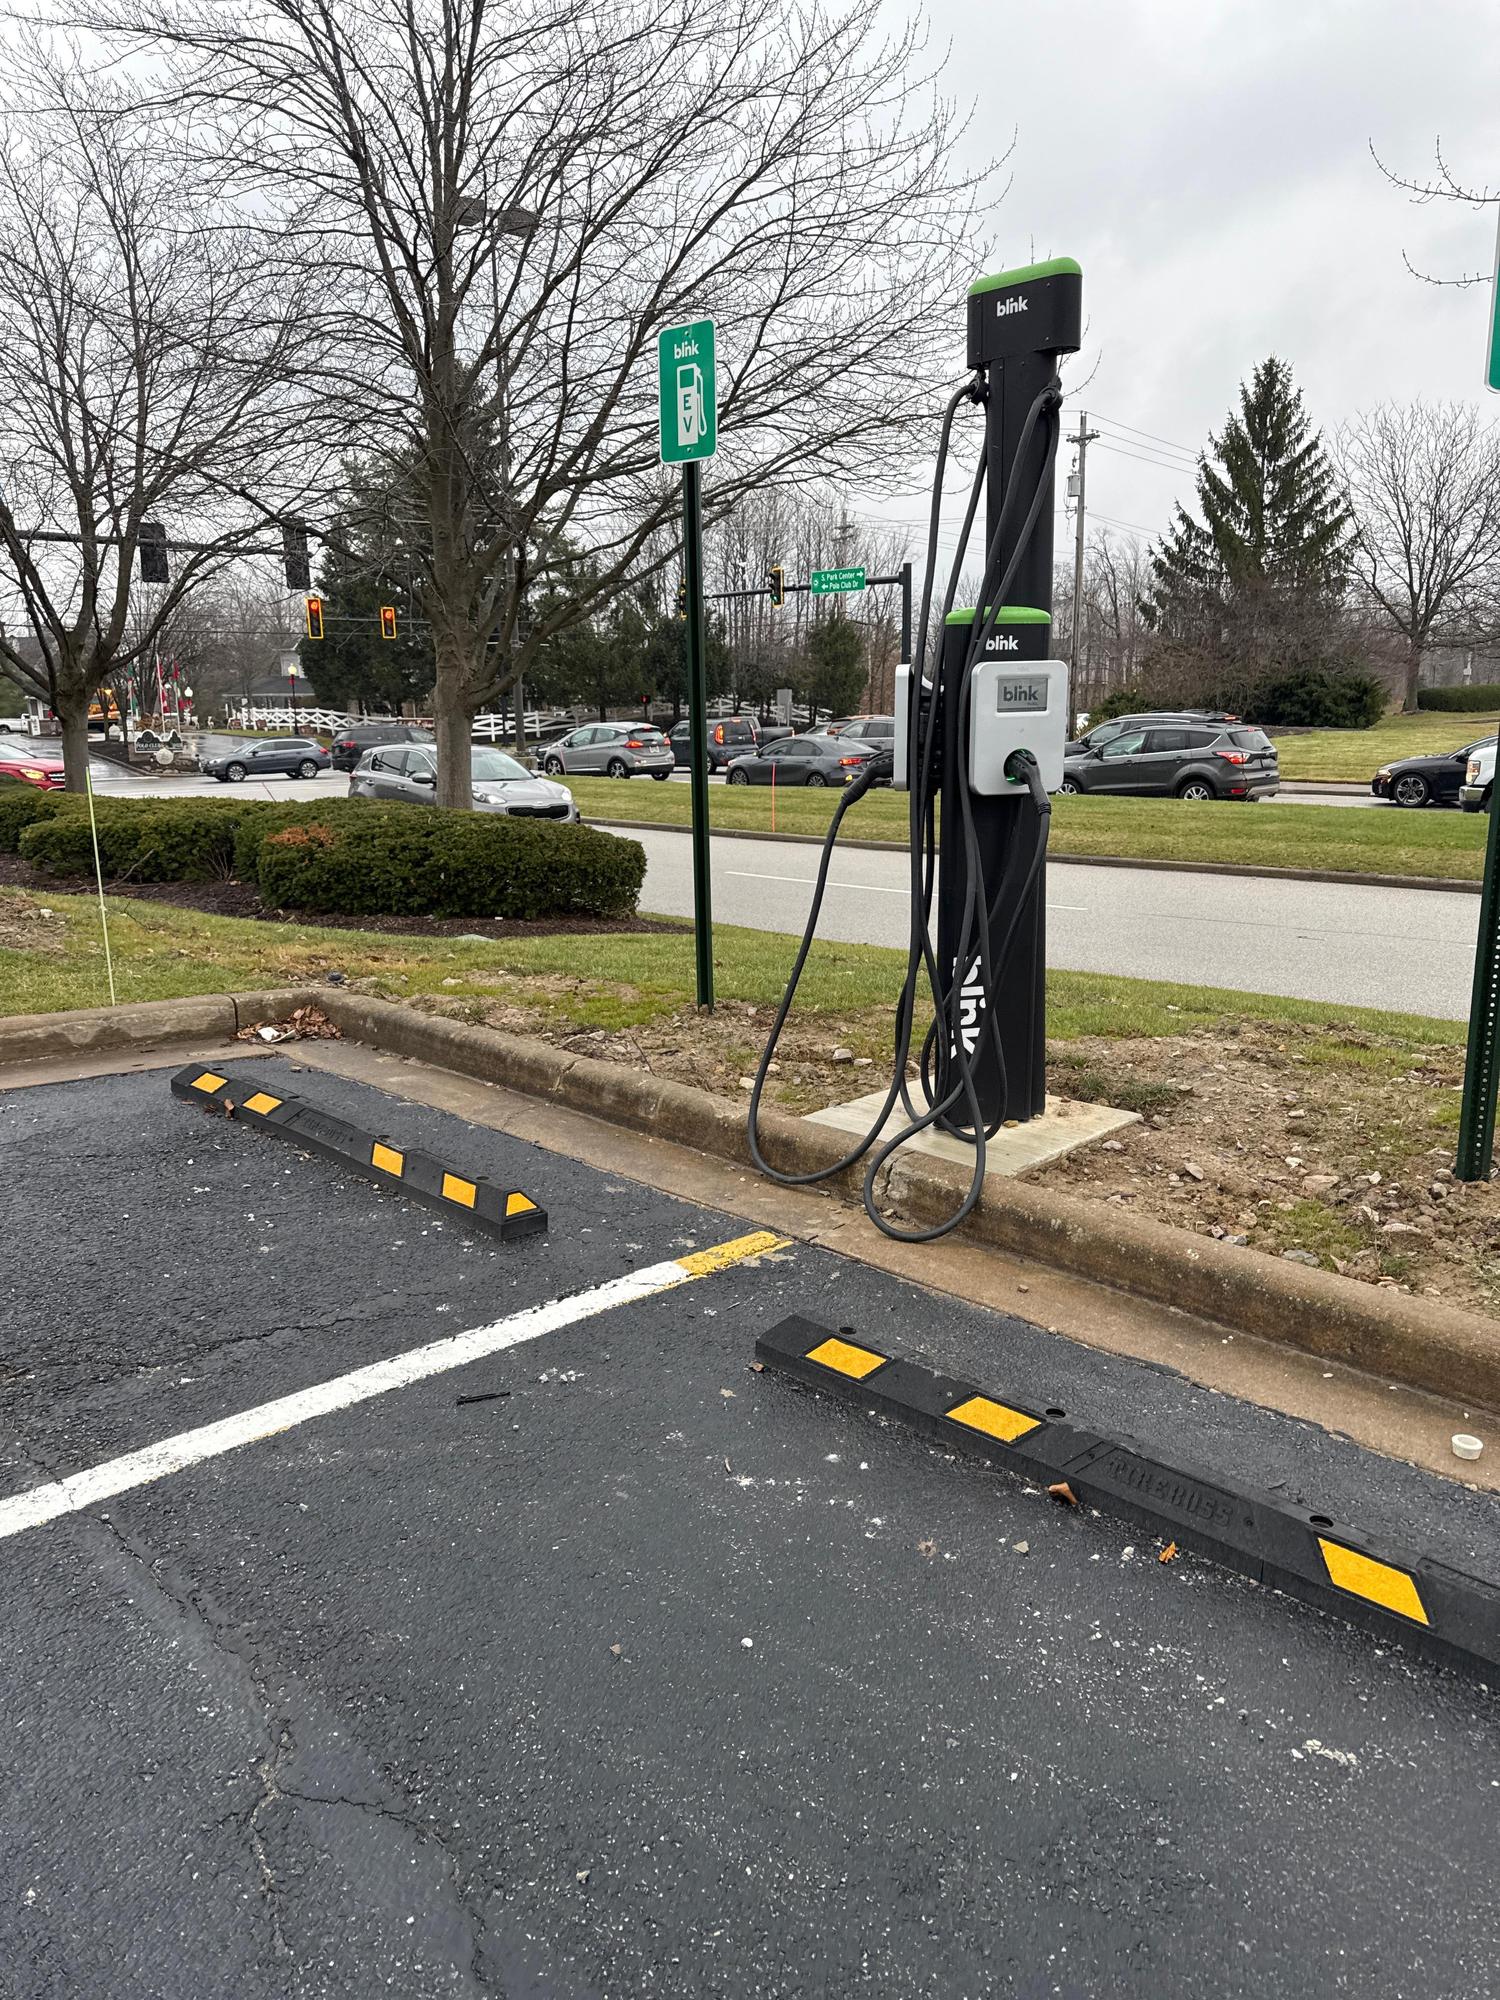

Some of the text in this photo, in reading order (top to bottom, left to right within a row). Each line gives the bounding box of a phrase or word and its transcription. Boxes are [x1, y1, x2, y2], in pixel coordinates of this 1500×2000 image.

[996, 296, 1028, 317] blink
[674, 340, 699, 359] blink
[827, 573, 838, 581] Park
[839, 572, 855, 580] Center
[829, 580, 859, 590] Polo Club Dr
[985, 635, 1019, 650] blink
[1003, 685, 1039, 702] blink
